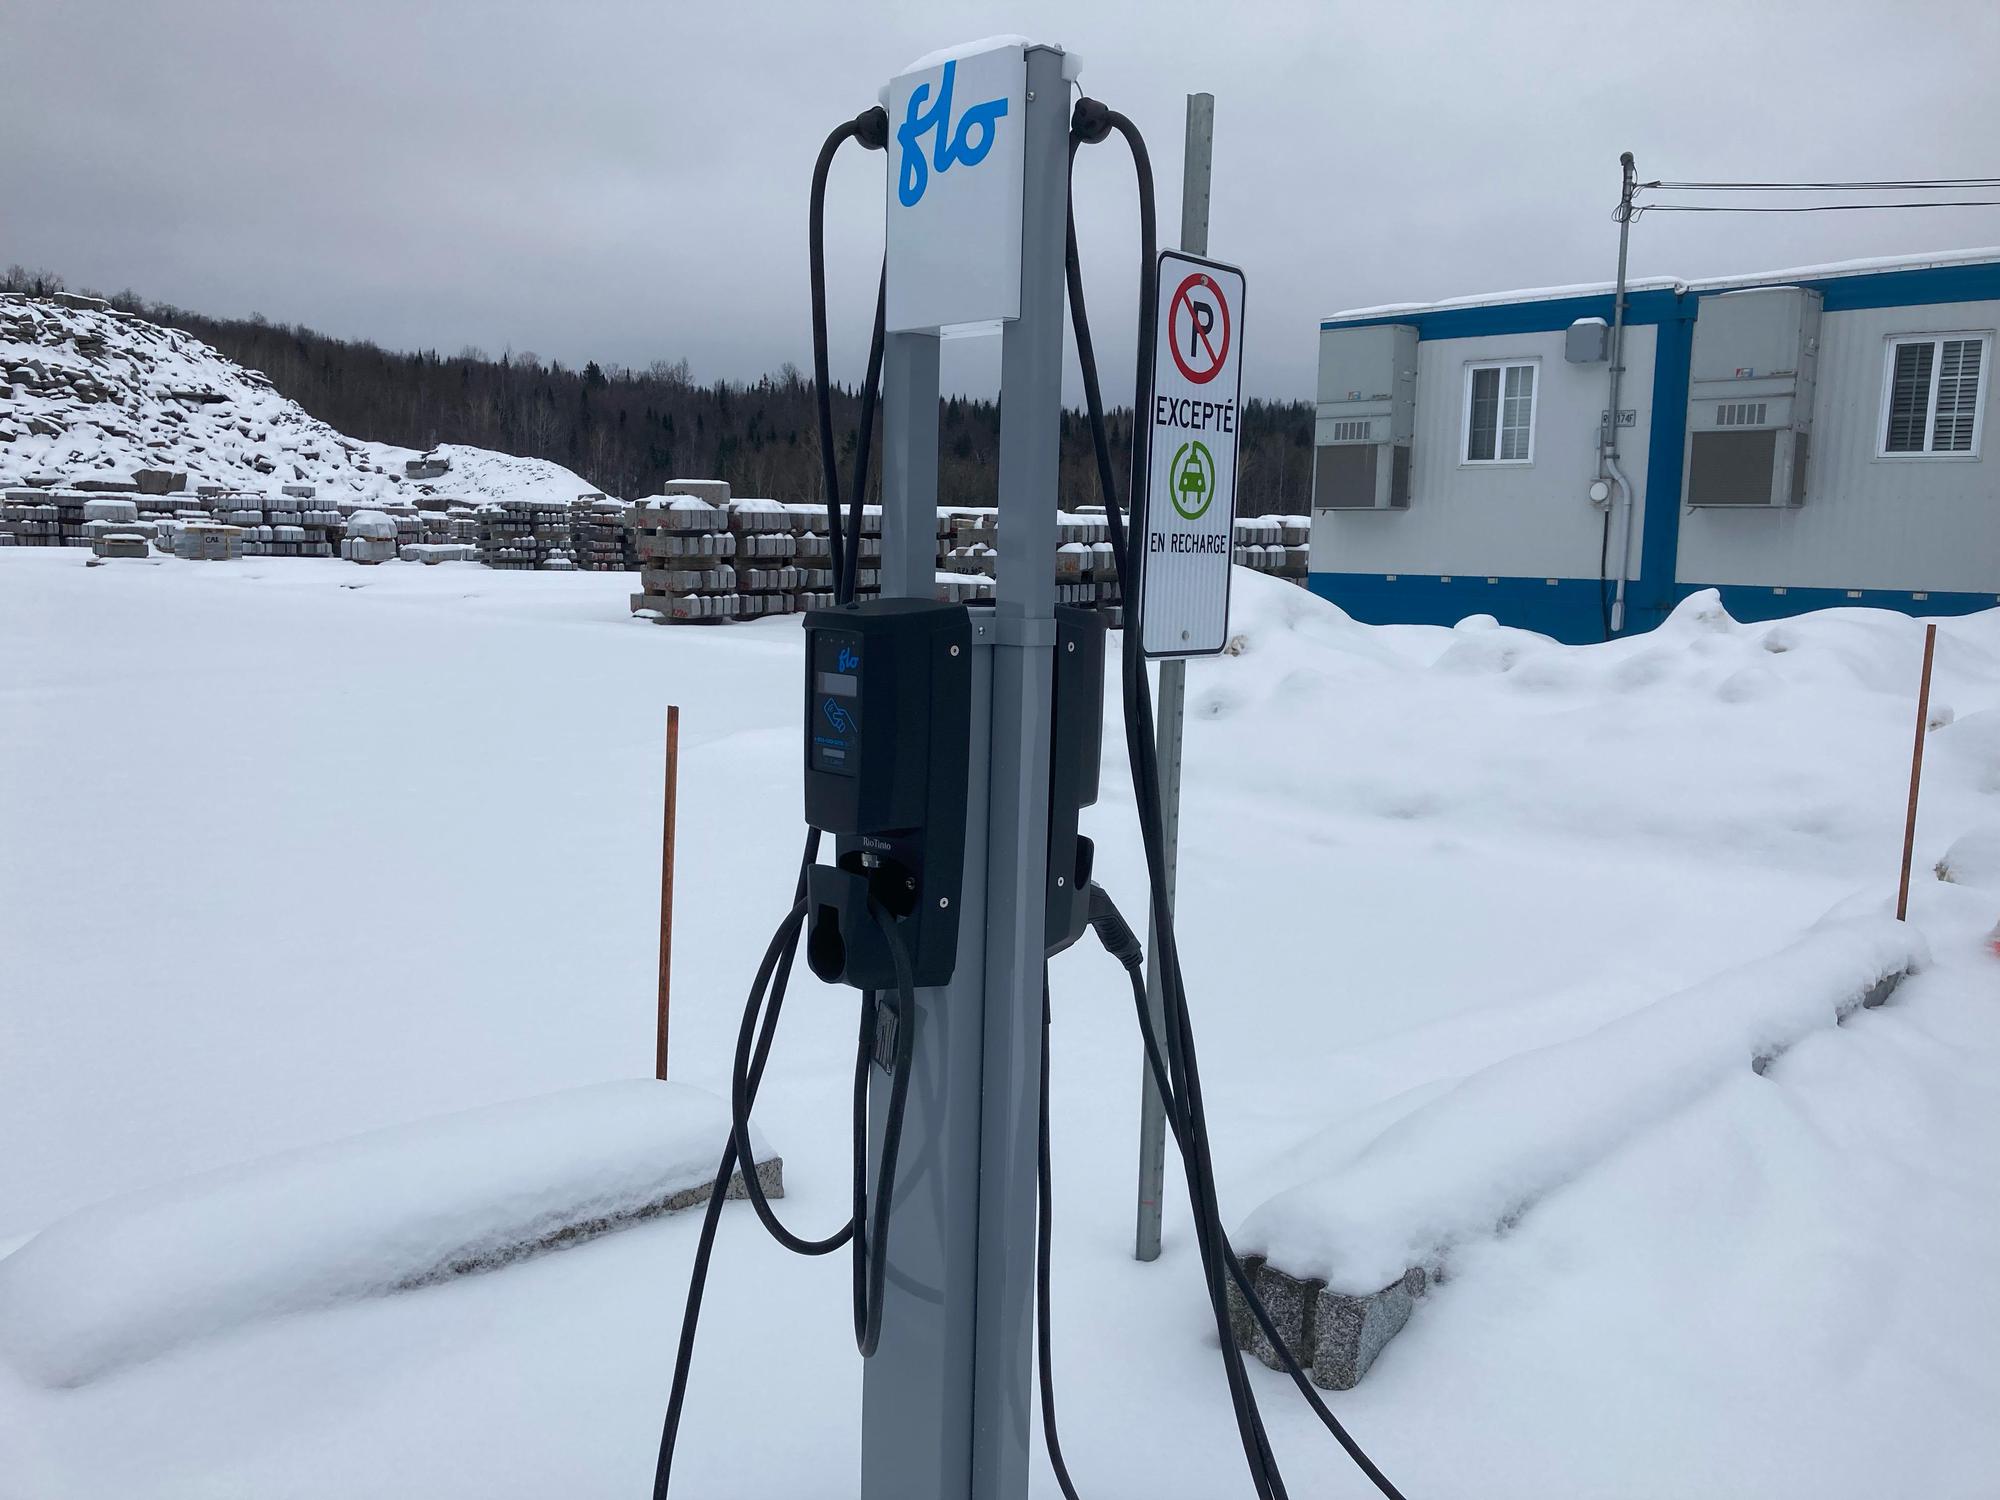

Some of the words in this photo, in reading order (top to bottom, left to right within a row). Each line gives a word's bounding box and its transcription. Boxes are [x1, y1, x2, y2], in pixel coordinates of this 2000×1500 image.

[897, 60, 1008, 207] flo
[1191, 301, 1214, 357] P
[1156, 396, 1234, 433] EXCEPTÉ
[1151, 533, 1165, 553] EN
[1171, 533, 1226, 554] RECHARGE
[837, 648, 859, 673] flo
